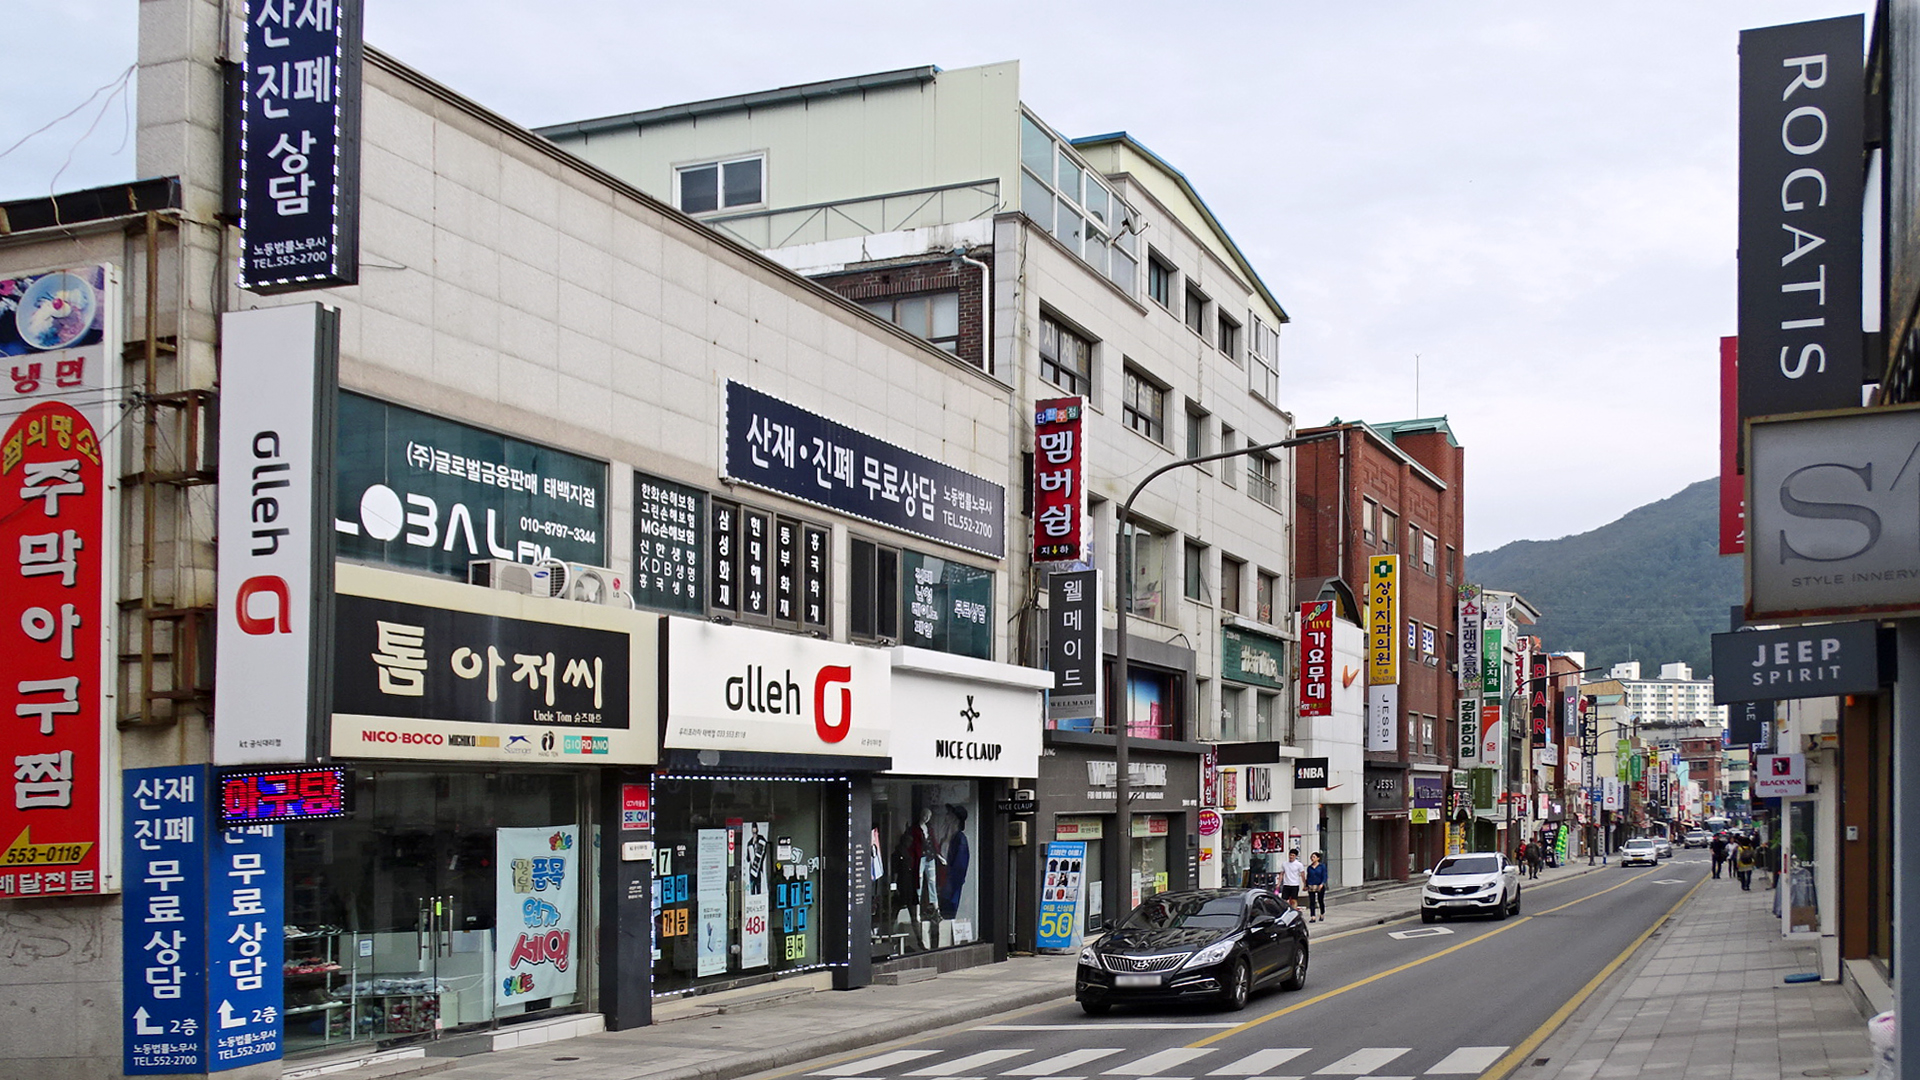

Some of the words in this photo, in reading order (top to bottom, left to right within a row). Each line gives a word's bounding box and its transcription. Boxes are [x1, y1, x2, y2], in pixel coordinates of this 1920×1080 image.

[255, 0, 332, 47] 산재
[256, 56, 331, 119] 진폐
[267, 130, 317, 216] 상담
[1780, 54, 1828, 380] ROGATIS
[252, 251, 327, 269] TEL.552-2700
[253, 238, 327, 256] 노동법률노무사
[11, 358, 85, 393] 냉면
[1035, 405, 1078, 425] 단란주점
[407, 441, 538, 495] (주)글로벌금융판매
[543, 478, 595, 508] 태백지점
[862, 456, 937, 522] 무료상담
[1040, 431, 1074, 537] 멤버쉽
[641, 483, 695, 512] 한화손해보험
[943, 485, 993, 515] 노동법률노무사
[641, 502, 695, 529] 그린손해보험
[942, 510, 993, 539] TEL.552-2700
[520, 516, 596, 545] 010-8797-3344
[641, 518, 695, 546] MG손해보험
[639, 539, 696, 566] 신한생명
[719, 510, 730, 606] 삼성화재
[750, 516, 761, 610] 현대해상
[639, 573, 696, 599] 흥국생명
[780, 526, 791, 617] 동부화재
[810, 533, 820, 623] 흥국화재
[1791, 575, 1844, 588] STYLE
[954, 600, 987, 624] 무료상담
[1461, 602, 1479, 616] 쇼
[1063, 580, 1083, 687] 웰메이드
[1375, 581, 1392, 667] 상아치과의원
[1463, 617, 1479, 679] 노래연습장
[1752, 638, 1841, 667] JEEP
[371, 620, 428, 697] 톰
[450, 645, 603, 709] 아저씨
[1307, 631, 1327, 700] 가요무대
[1752, 665, 1841, 685] SPIRIT
[725, 665, 801, 716] olleh
[1533, 664, 1547, 735] BAR
[533, 710, 554, 722] Uncle
[556, 711, 572, 723] Tom
[1382, 694, 1390, 743] JESSI
[565, 738, 608, 752] GIORDANO
[936, 740, 963, 759] NICE
[966, 743, 1002, 762] CLAUP
[1253, 768, 1271, 801] NBA
[1303, 767, 1325, 779] NBA
[1760, 779, 1785, 788] BLACK
[1786, 778, 1802, 787] YAK
[133, 776, 194, 811] 산재
[134, 817, 194, 851] 진폐
[6, 845, 81, 864] 553-0118
[531, 856, 566, 890] 품목
[777, 884, 812, 907] LTE
[144, 860, 187, 1000] 무료상담
[228, 853, 267, 992] 무료상담
[1039, 912, 1074, 938] 50
[510, 929, 571, 972] 세일
[170, 1019, 199, 1036] 2층
[252, 1007, 278, 1023] 2층
[133, 1042, 197, 1054] 노동법률노무사
[217, 1029, 277, 1048] 노동법률노무사
[218, 1042, 276, 1060] TEL.552-2700
[133, 1055, 197, 1066] TEL.552-2700
